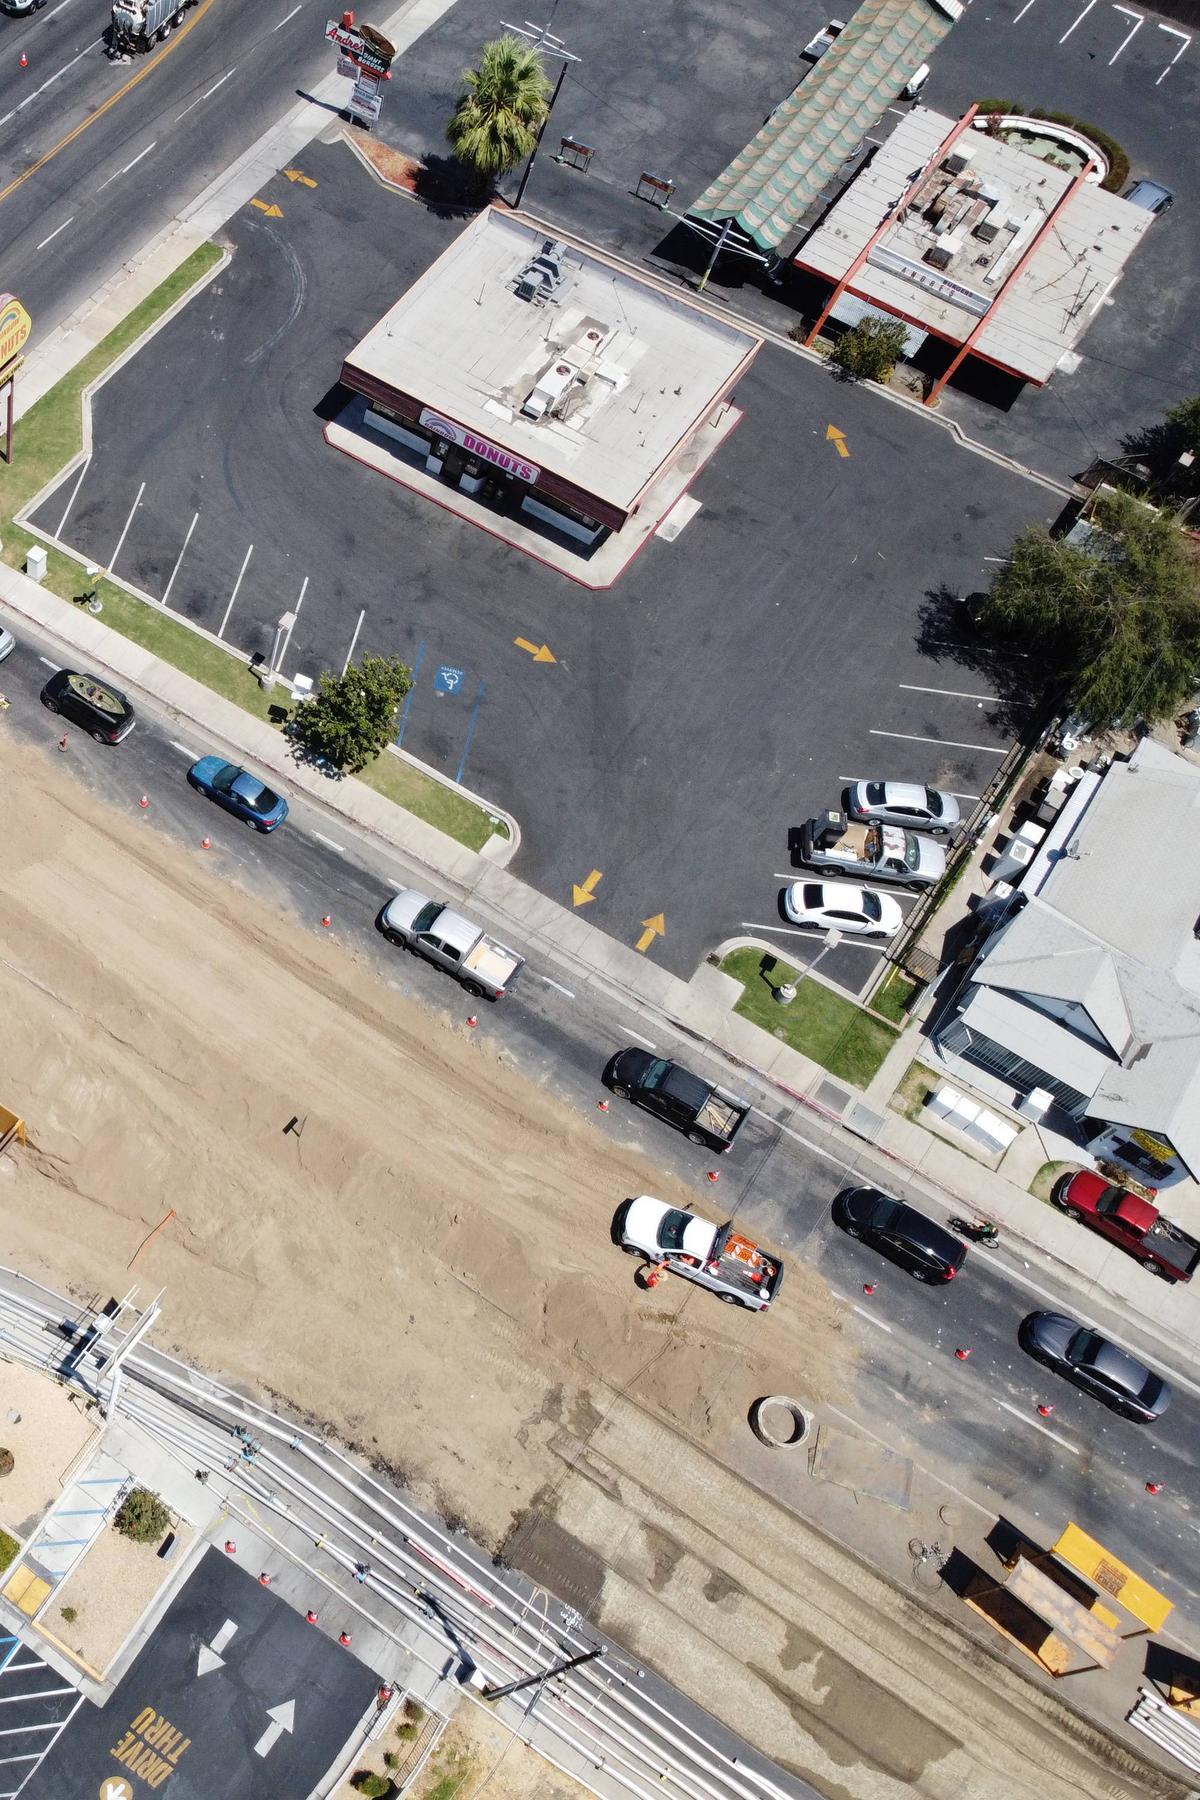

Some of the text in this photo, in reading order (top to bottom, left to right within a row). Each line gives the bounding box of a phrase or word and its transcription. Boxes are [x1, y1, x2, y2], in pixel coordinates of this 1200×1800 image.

[357, 56, 385, 73] BURGERS
[362, 53, 382, 65] GIANT
[942, 280, 974, 298] BURGERS
[463, 434, 532, 480] DONUTS
[130, 1706, 192, 1765] THRU
[110, 1731, 175, 1789] DRIVE
